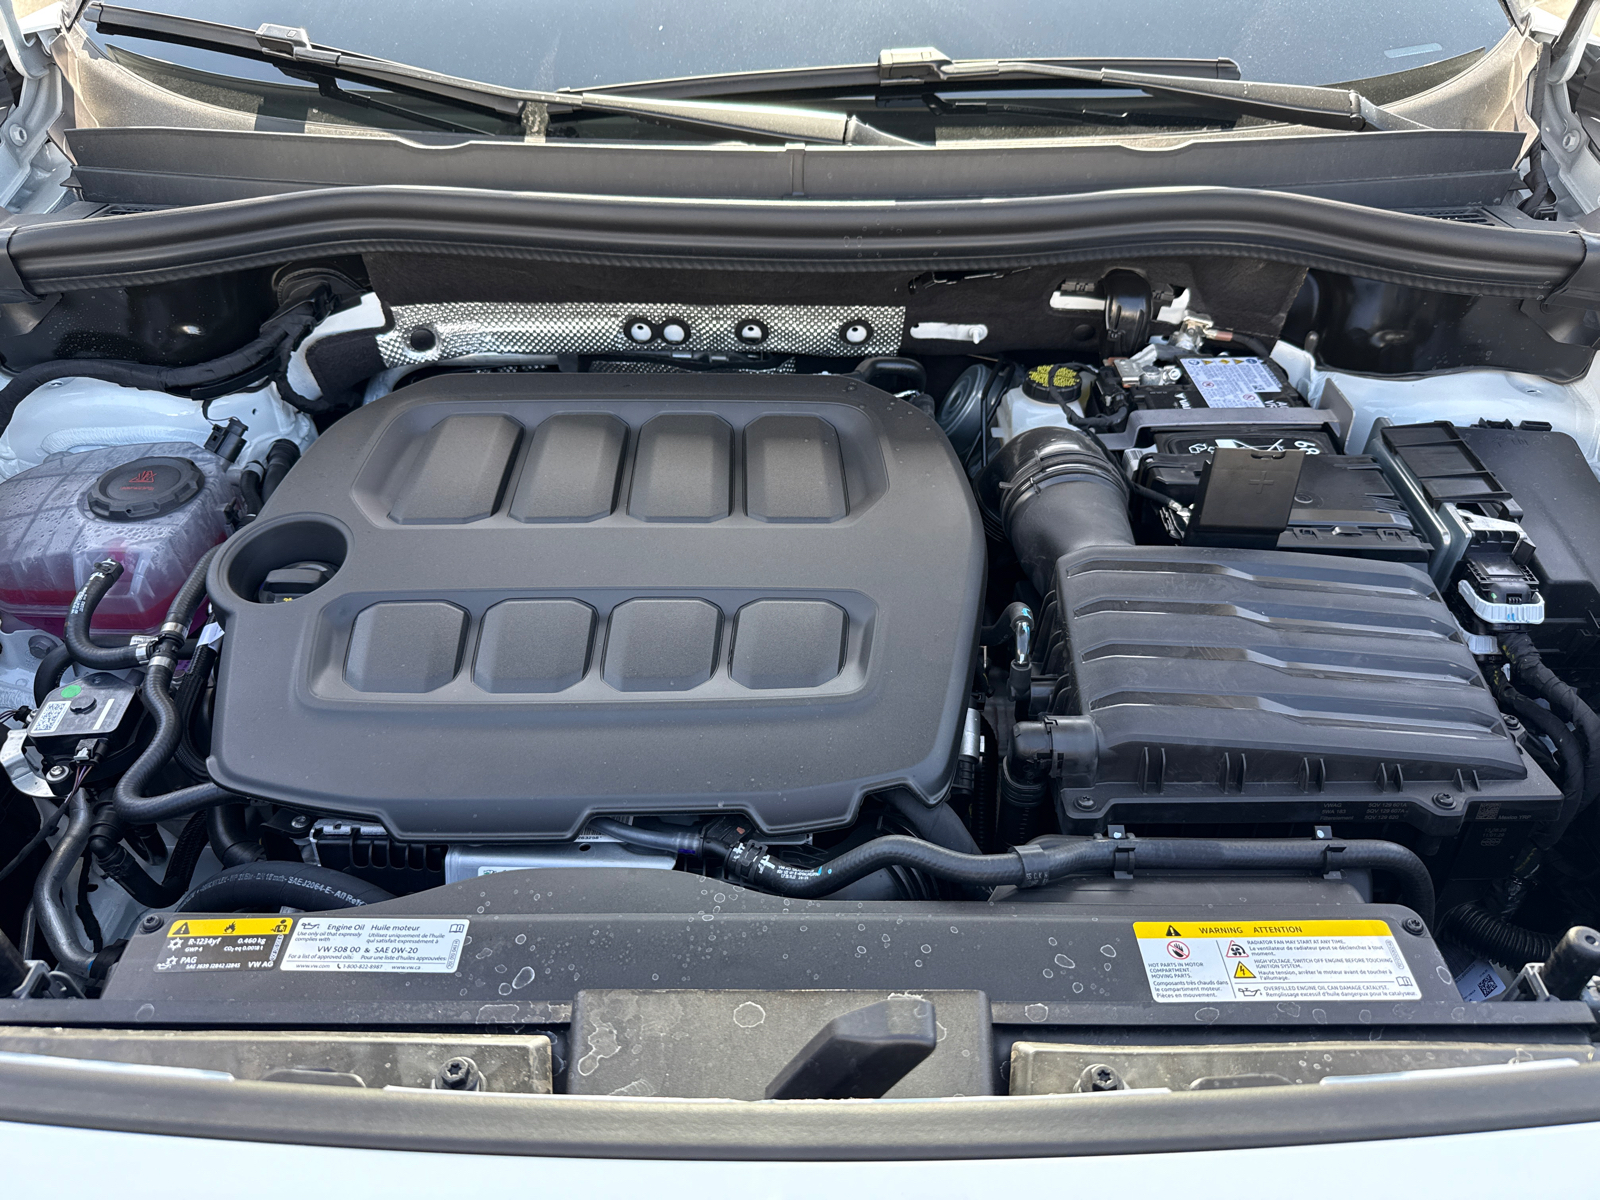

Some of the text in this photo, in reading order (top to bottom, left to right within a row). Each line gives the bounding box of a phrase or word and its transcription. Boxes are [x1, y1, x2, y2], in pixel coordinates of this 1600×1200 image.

[327, 924, 353, 932] Engine
[1254, 926, 1302, 934] ATTENTION
[188, 938, 222, 946] R-1234yf
[258, 938, 266, 946] kg
